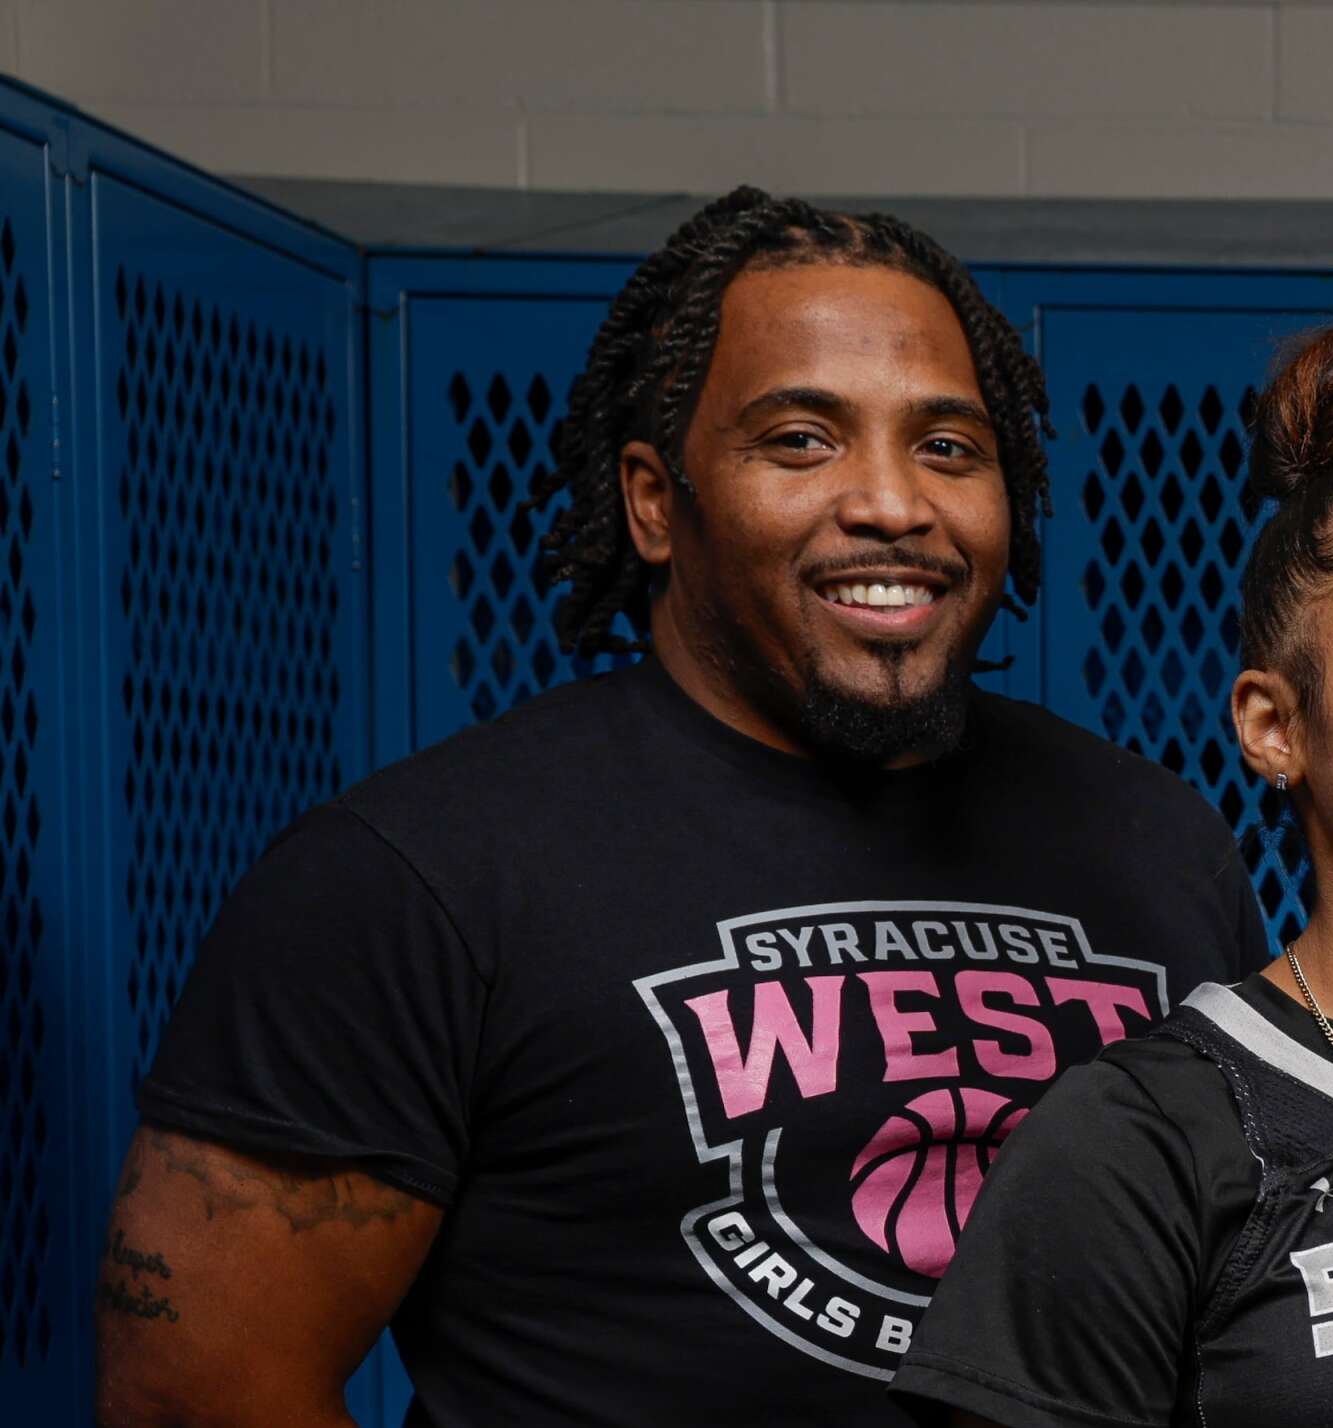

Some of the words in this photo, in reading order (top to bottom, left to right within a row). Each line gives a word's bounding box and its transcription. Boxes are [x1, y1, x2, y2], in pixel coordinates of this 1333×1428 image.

[744, 919, 1080, 971] SYRACUSE
[683, 969, 1152, 1120] WEST
[706, 1210, 860, 1339] GIRLS
